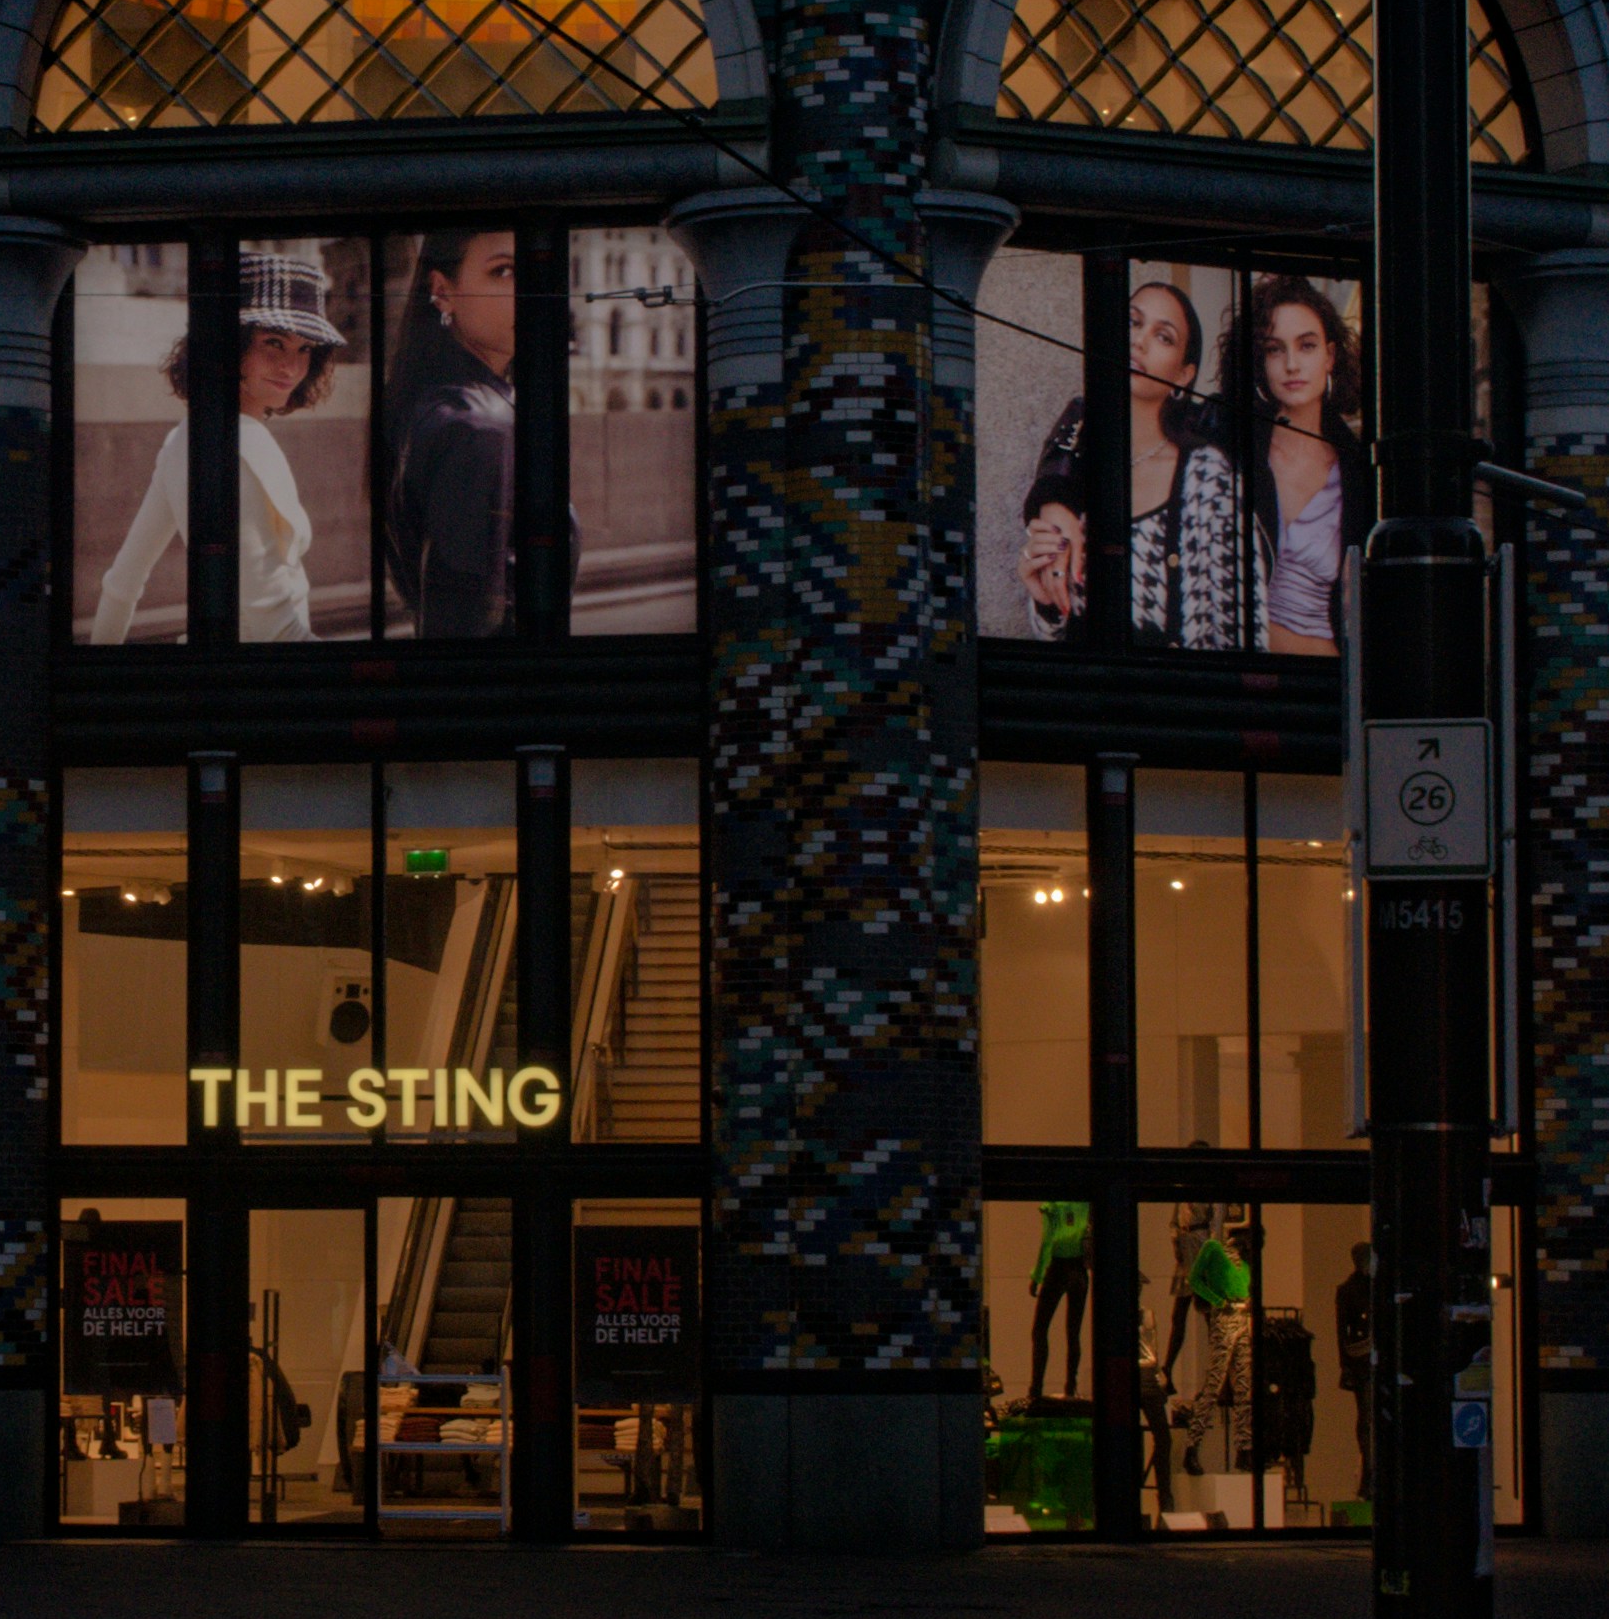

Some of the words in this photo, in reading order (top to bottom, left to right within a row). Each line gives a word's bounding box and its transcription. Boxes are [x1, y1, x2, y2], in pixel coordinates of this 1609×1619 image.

[1408, 786, 1445, 810] 26
[190, 1069, 323, 1127] THE
[346, 1067, 561, 1128] STING
[82, 1251, 166, 1276] FINAL
[595, 1256, 681, 1283] FINAL
[82, 1277, 166, 1306] SALE
[596, 1283, 682, 1313] SALE
[83, 1307, 124, 1319] ALLES
[126, 1307, 166, 1319] VOOR
[596, 1314, 638, 1326] ALLES
[639, 1314, 681, 1326] VOOR
[83, 1320, 106, 1336] DE
[110, 1320, 166, 1336] HELFT
[595, 1328, 619, 1344] DE
[623, 1328, 681, 1344] HELFT
